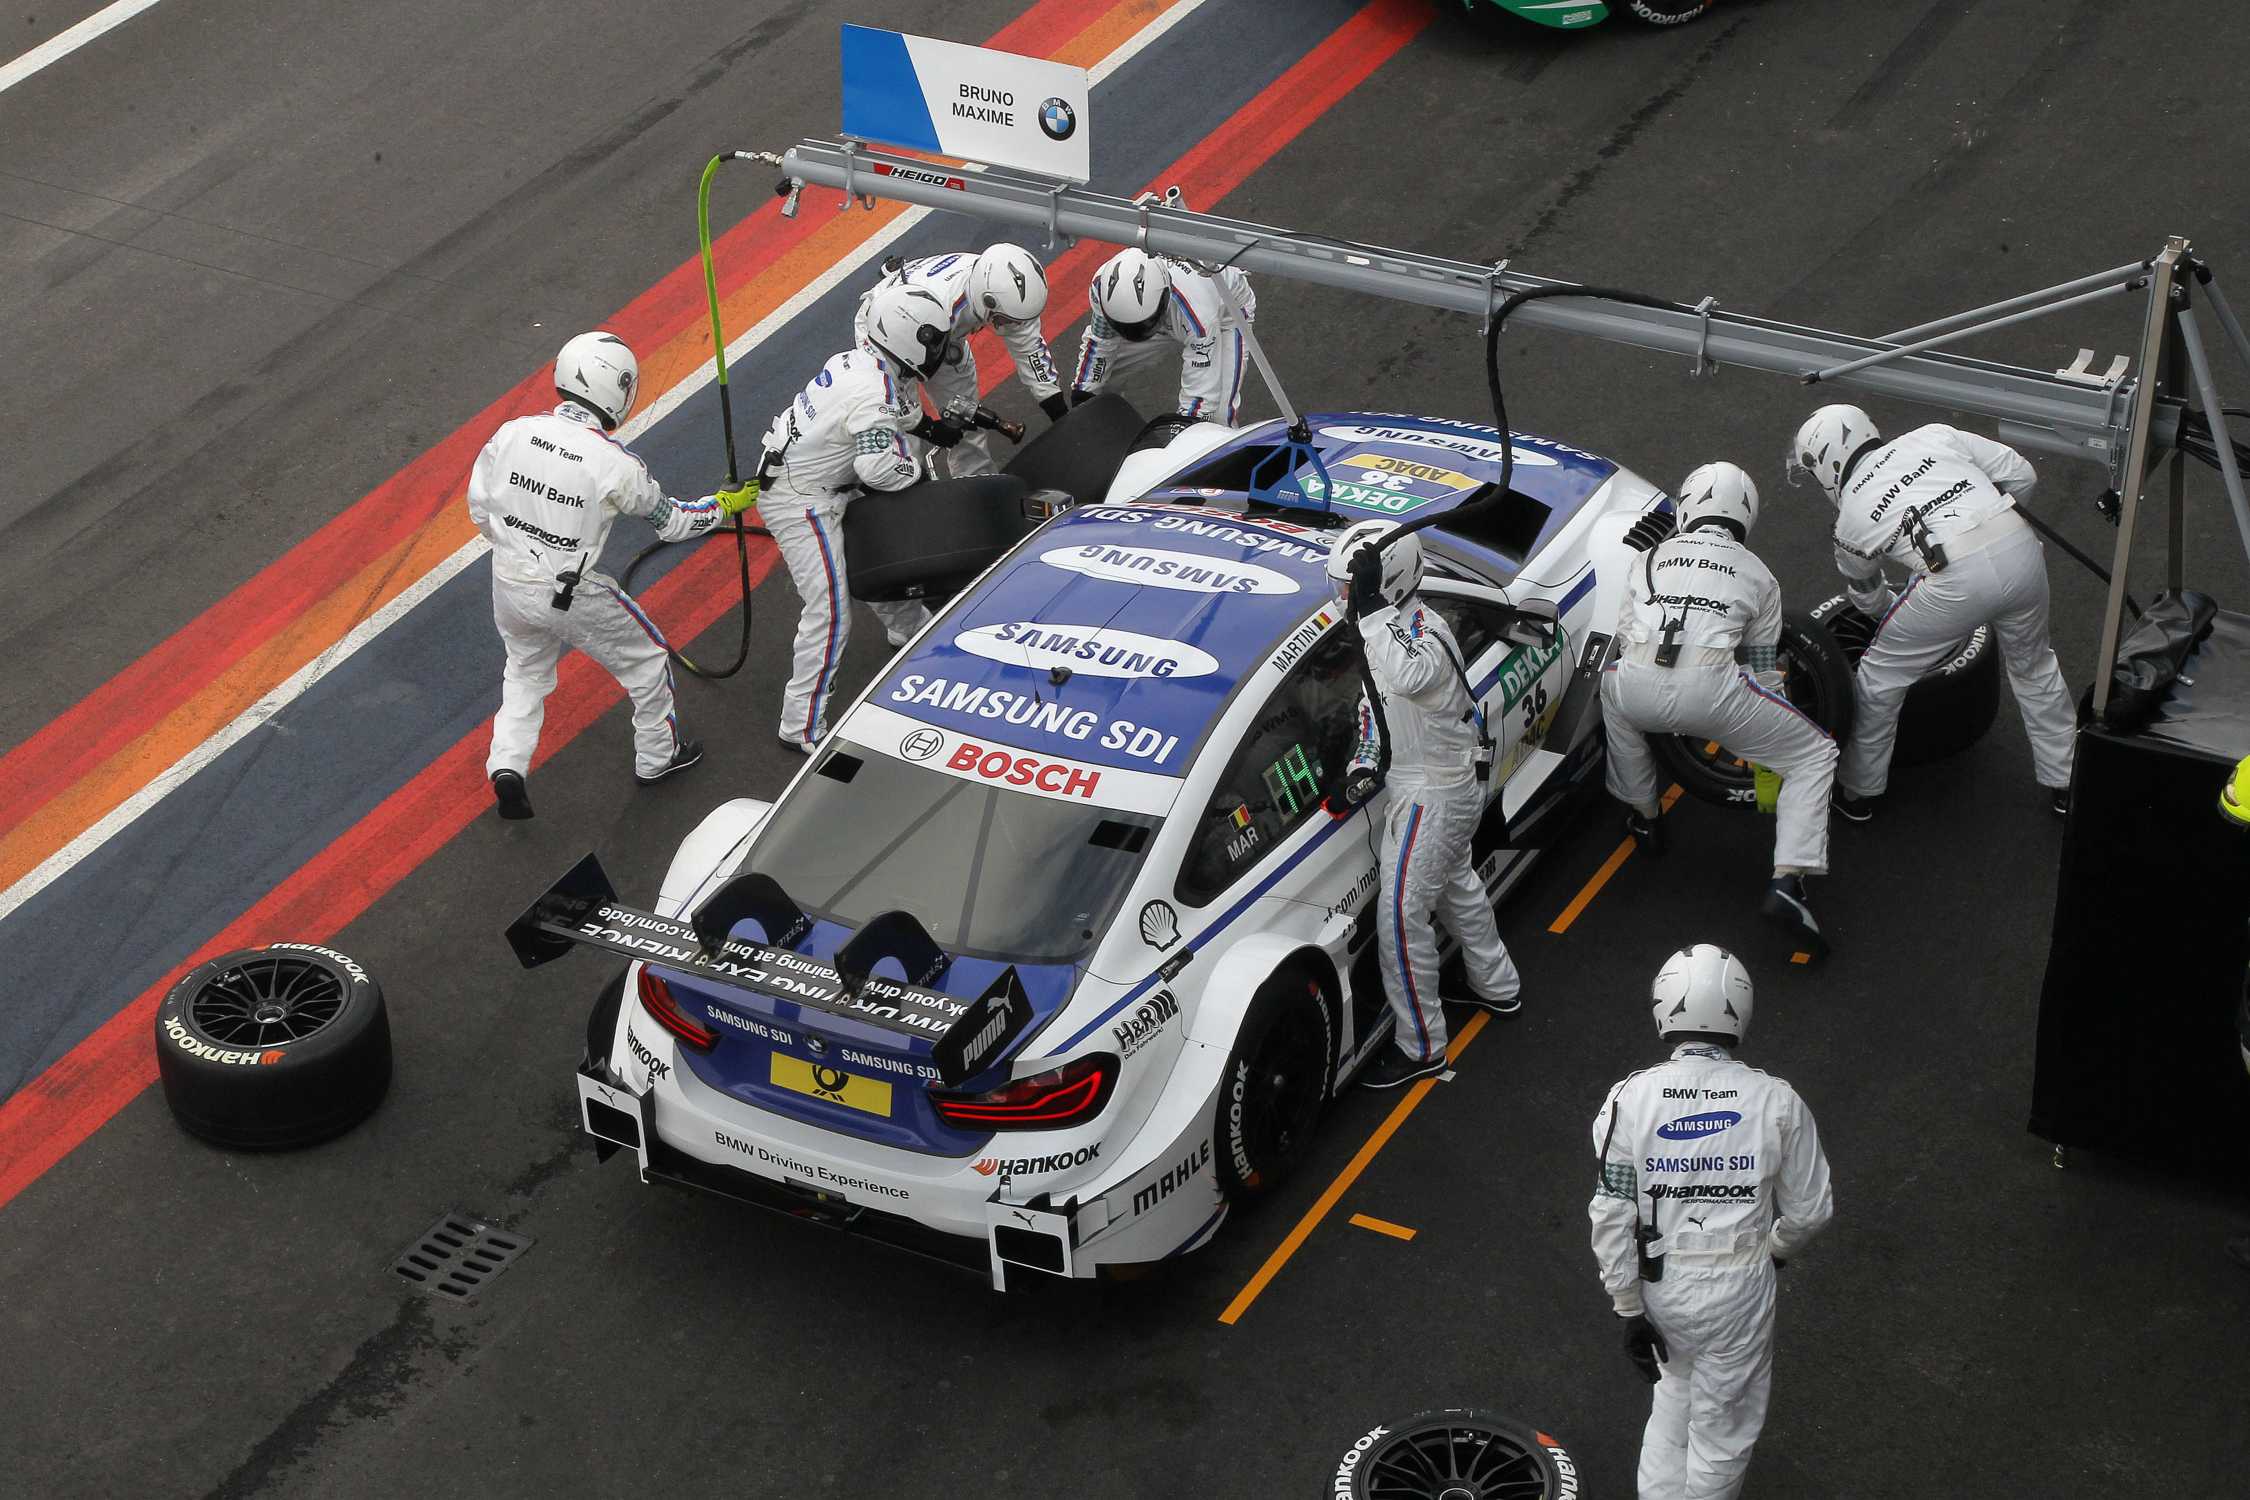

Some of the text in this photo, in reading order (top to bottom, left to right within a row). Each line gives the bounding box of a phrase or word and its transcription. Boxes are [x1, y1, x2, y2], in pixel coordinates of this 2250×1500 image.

[959, 83, 1014, 107] BRUNO
[952, 102, 1015, 127] MAXIME
[891, 167, 947, 186] HEIGO
[530, 436, 584, 464] BMW Team
[1360, 470, 1414, 491] 36
[1375, 458, 1450, 481] ADAC
[1852, 471, 1876, 494] BMW
[509, 471, 585, 509] BMW Bank
[1870, 455, 1938, 523] BMW Bank
[1080, 507, 1329, 564] AMSUNG SDI
[1079, 545, 1261, 593] SAMSUNG
[1656, 557, 1737, 579] BMW Bank
[994, 622, 1179, 679] SAMSUNG
[1272, 624, 1320, 673] MARTIN
[891, 674, 1181, 767] SAMSUNG SDI
[1521, 679, 1548, 729] 36
[946, 742, 1102, 799] BOSCH
[1226, 826, 1260, 862] MAR
[900, 991, 950, 1010] your
[707, 1004, 793, 1046] SAMSUNG SDI
[962, 1008, 1008, 1072] PUMA
[1112, 1004, 1162, 1053] H&R
[842, 1049, 942, 1080] SAMSUNG SDI
[1663, 1088, 1738, 1100] BMW Team
[1667, 1118, 1732, 1132] SAMSUNG
[715, 1131, 911, 1200] BMW Driving Experience
[1133, 1138, 1210, 1217] MAHLE
[1645, 1155, 1755, 1173] SAMSUNG SDI
